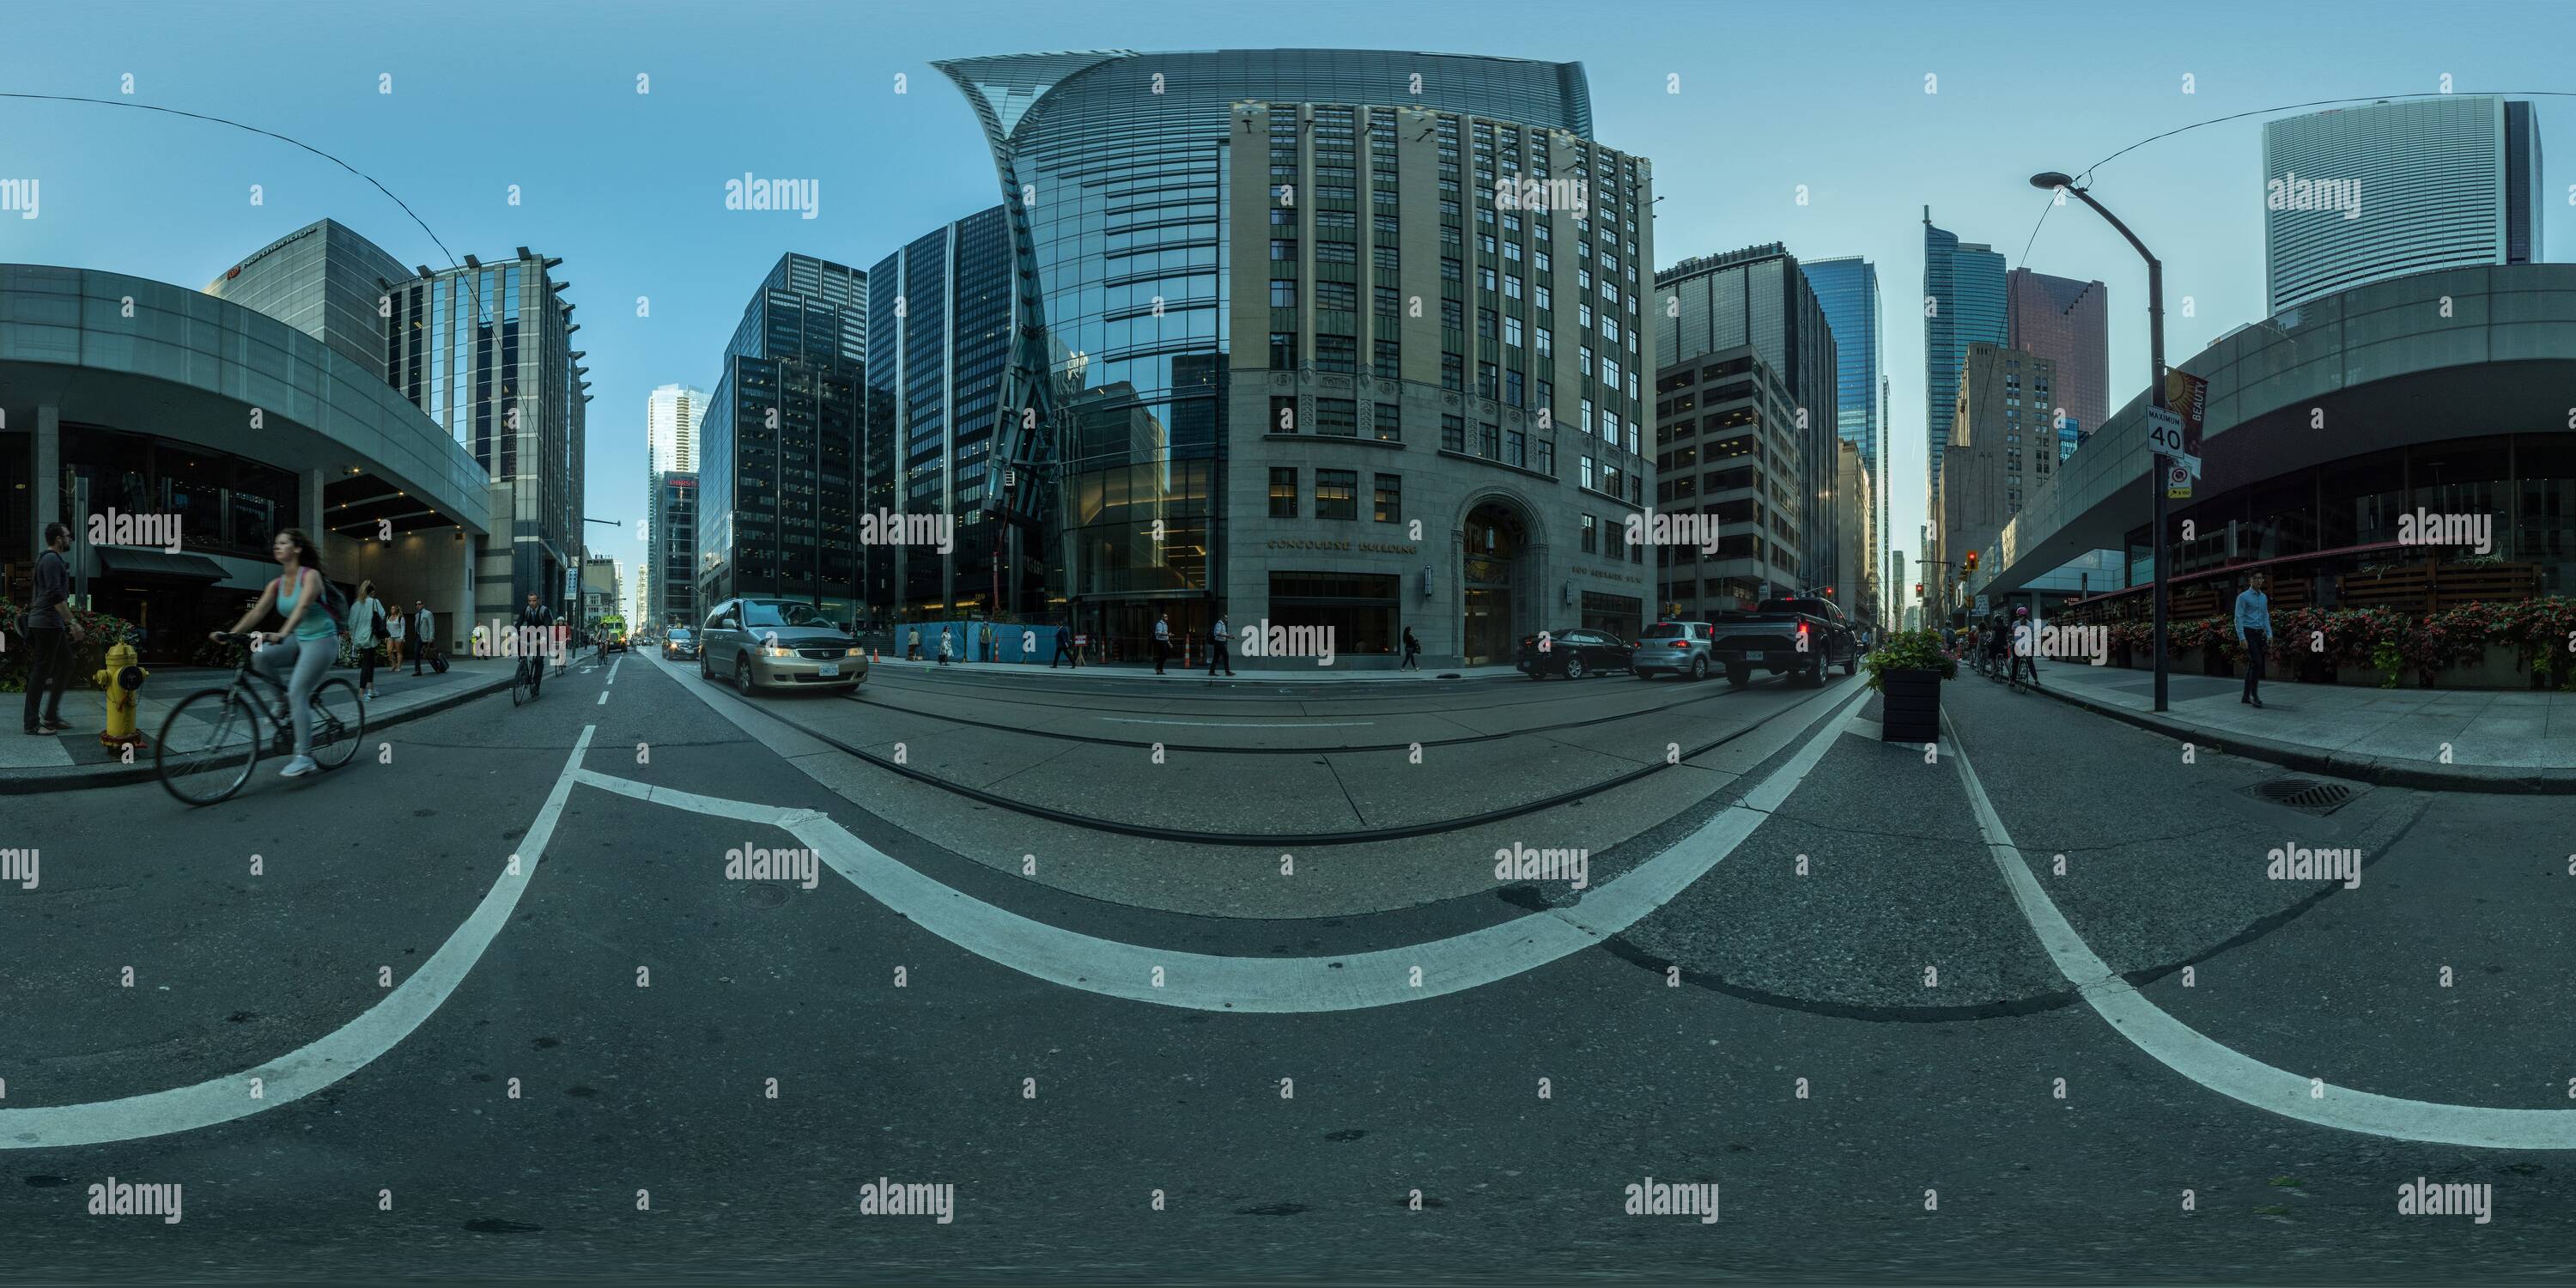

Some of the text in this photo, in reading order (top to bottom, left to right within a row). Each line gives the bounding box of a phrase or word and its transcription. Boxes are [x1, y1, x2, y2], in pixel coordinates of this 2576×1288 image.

[2192, 381, 2205, 422] BEAUTY
[2148, 410, 2180, 426] MAXIMUM
[2150, 426, 2181, 450] 40
[1267, 540, 1417, 555] CONCOURSE BUILDING
